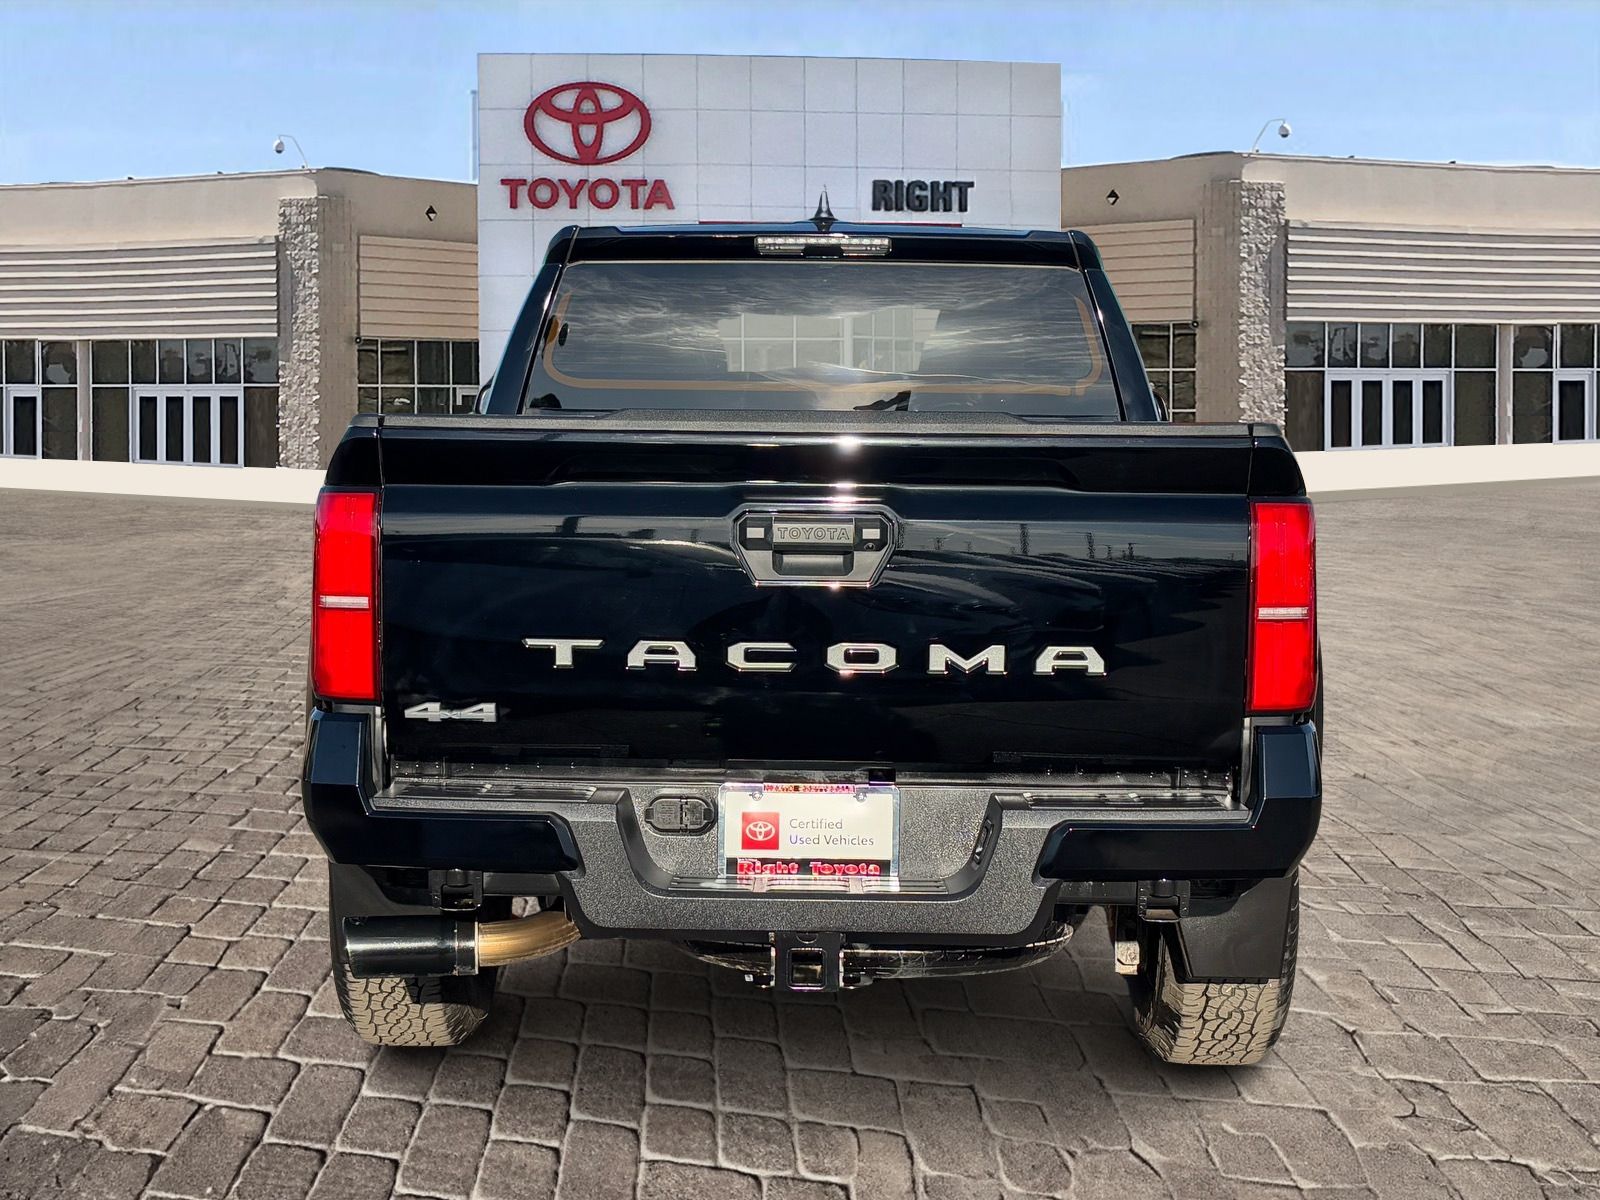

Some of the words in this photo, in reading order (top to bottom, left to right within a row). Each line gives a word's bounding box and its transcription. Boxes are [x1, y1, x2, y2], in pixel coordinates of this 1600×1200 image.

[500, 178, 675, 210] TOYOTA
[871, 180, 975, 213] RIGHT
[777, 527, 850, 540] TOYOTA
[522, 637, 1108, 676] TACOMA
[789, 818, 843, 830] Certified
[789, 834, 820, 846] Used
[825, 835, 875, 847] Vehicles
[736, 859, 798, 876] Right
[809, 861, 881, 876] Toyota
